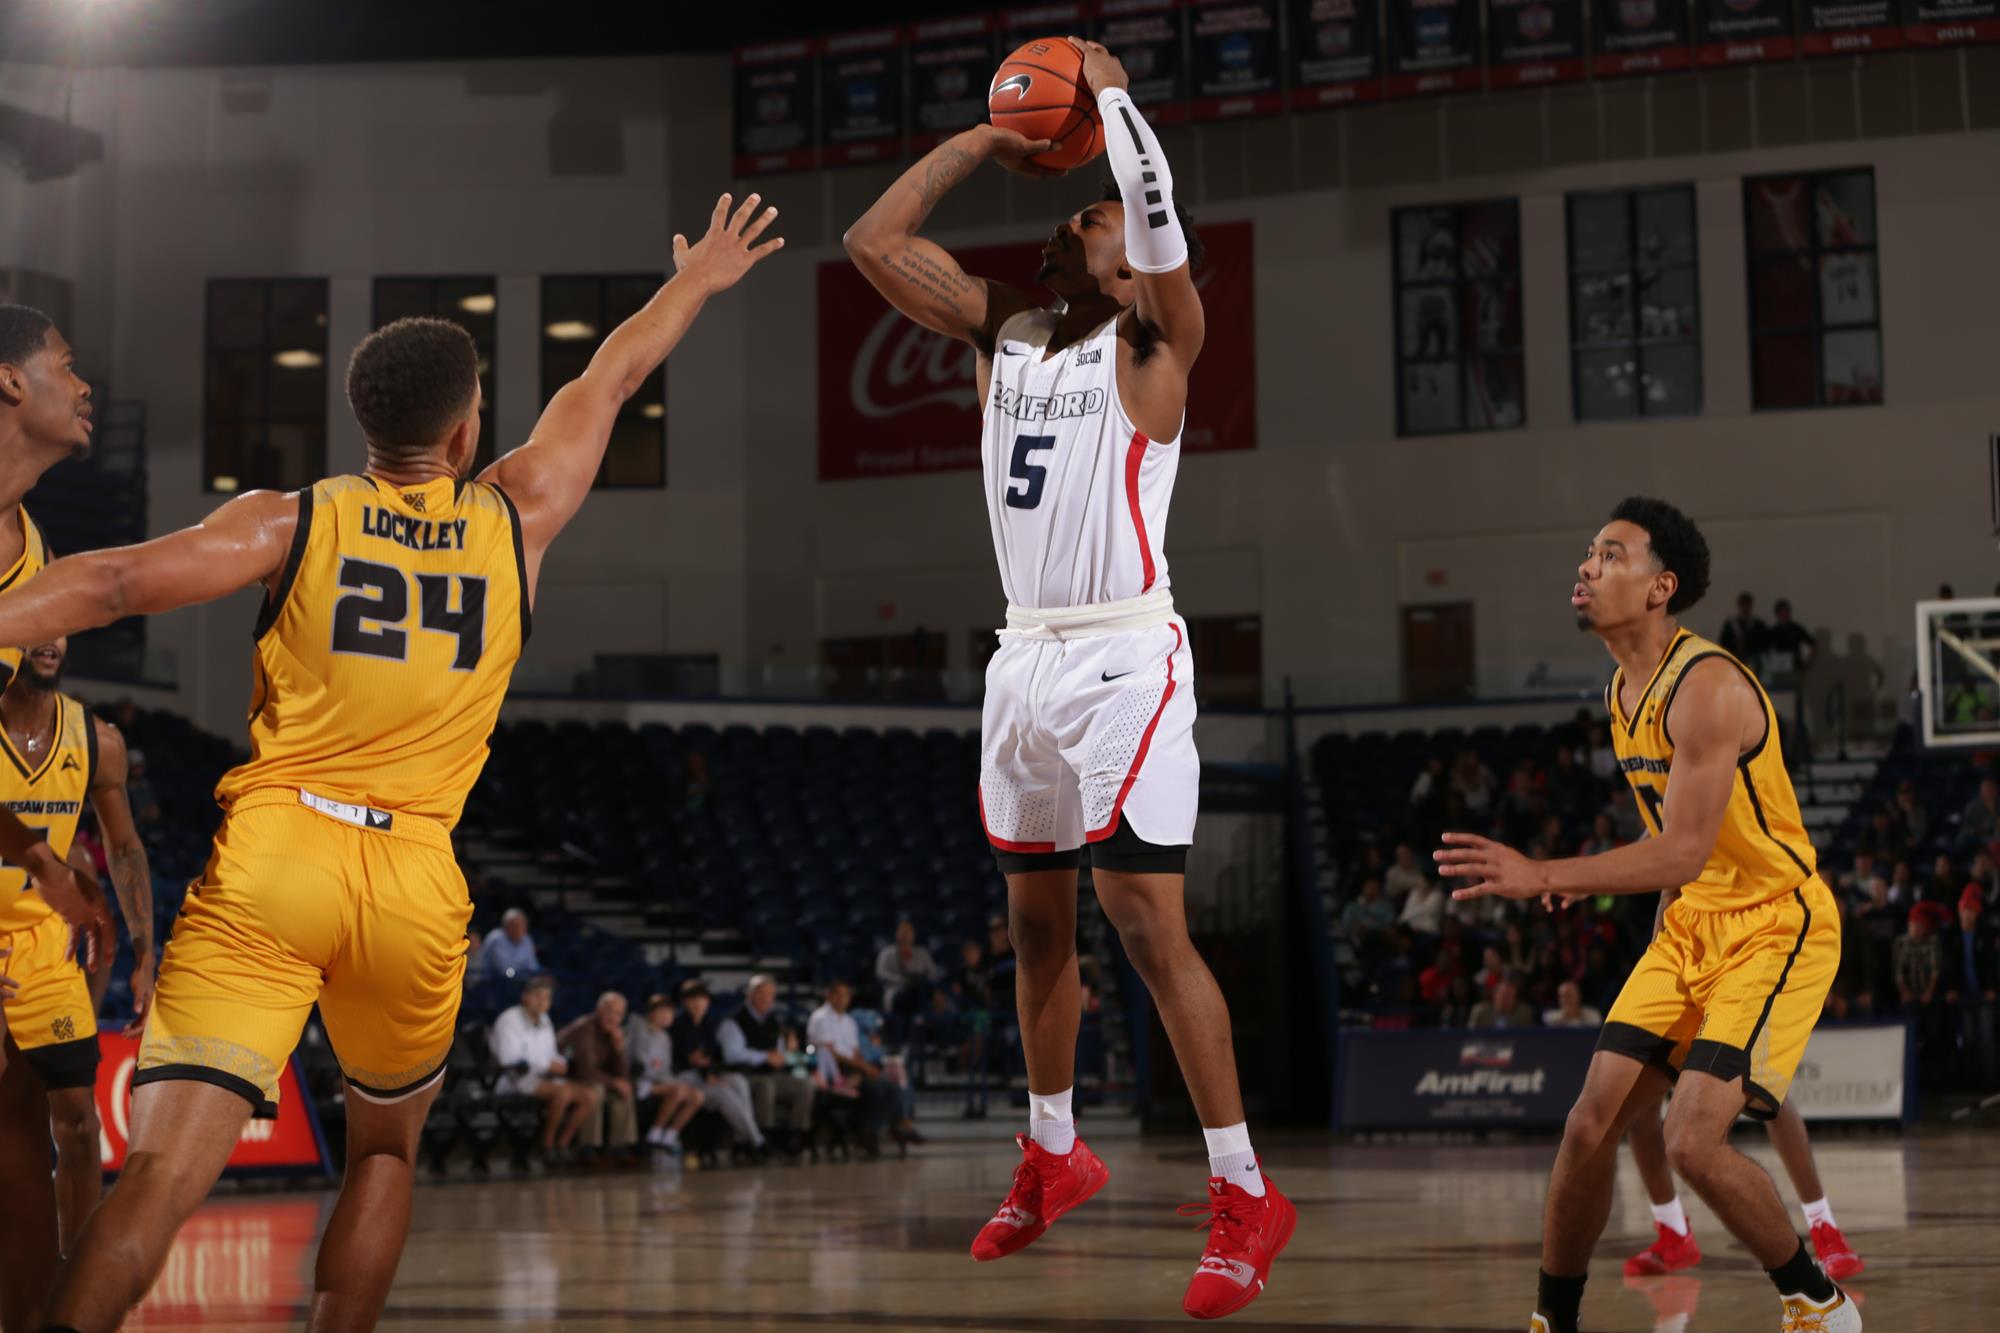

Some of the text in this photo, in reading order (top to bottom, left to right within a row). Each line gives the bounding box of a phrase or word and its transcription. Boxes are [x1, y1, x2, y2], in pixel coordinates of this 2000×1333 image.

[1075, 348, 1102, 368] SOCON
[1006, 434, 1056, 510] 5
[362, 506, 467, 550] LOCKLEY
[330, 554, 488, 672] 24
[1415, 1069, 1545, 1095] AmFirst
